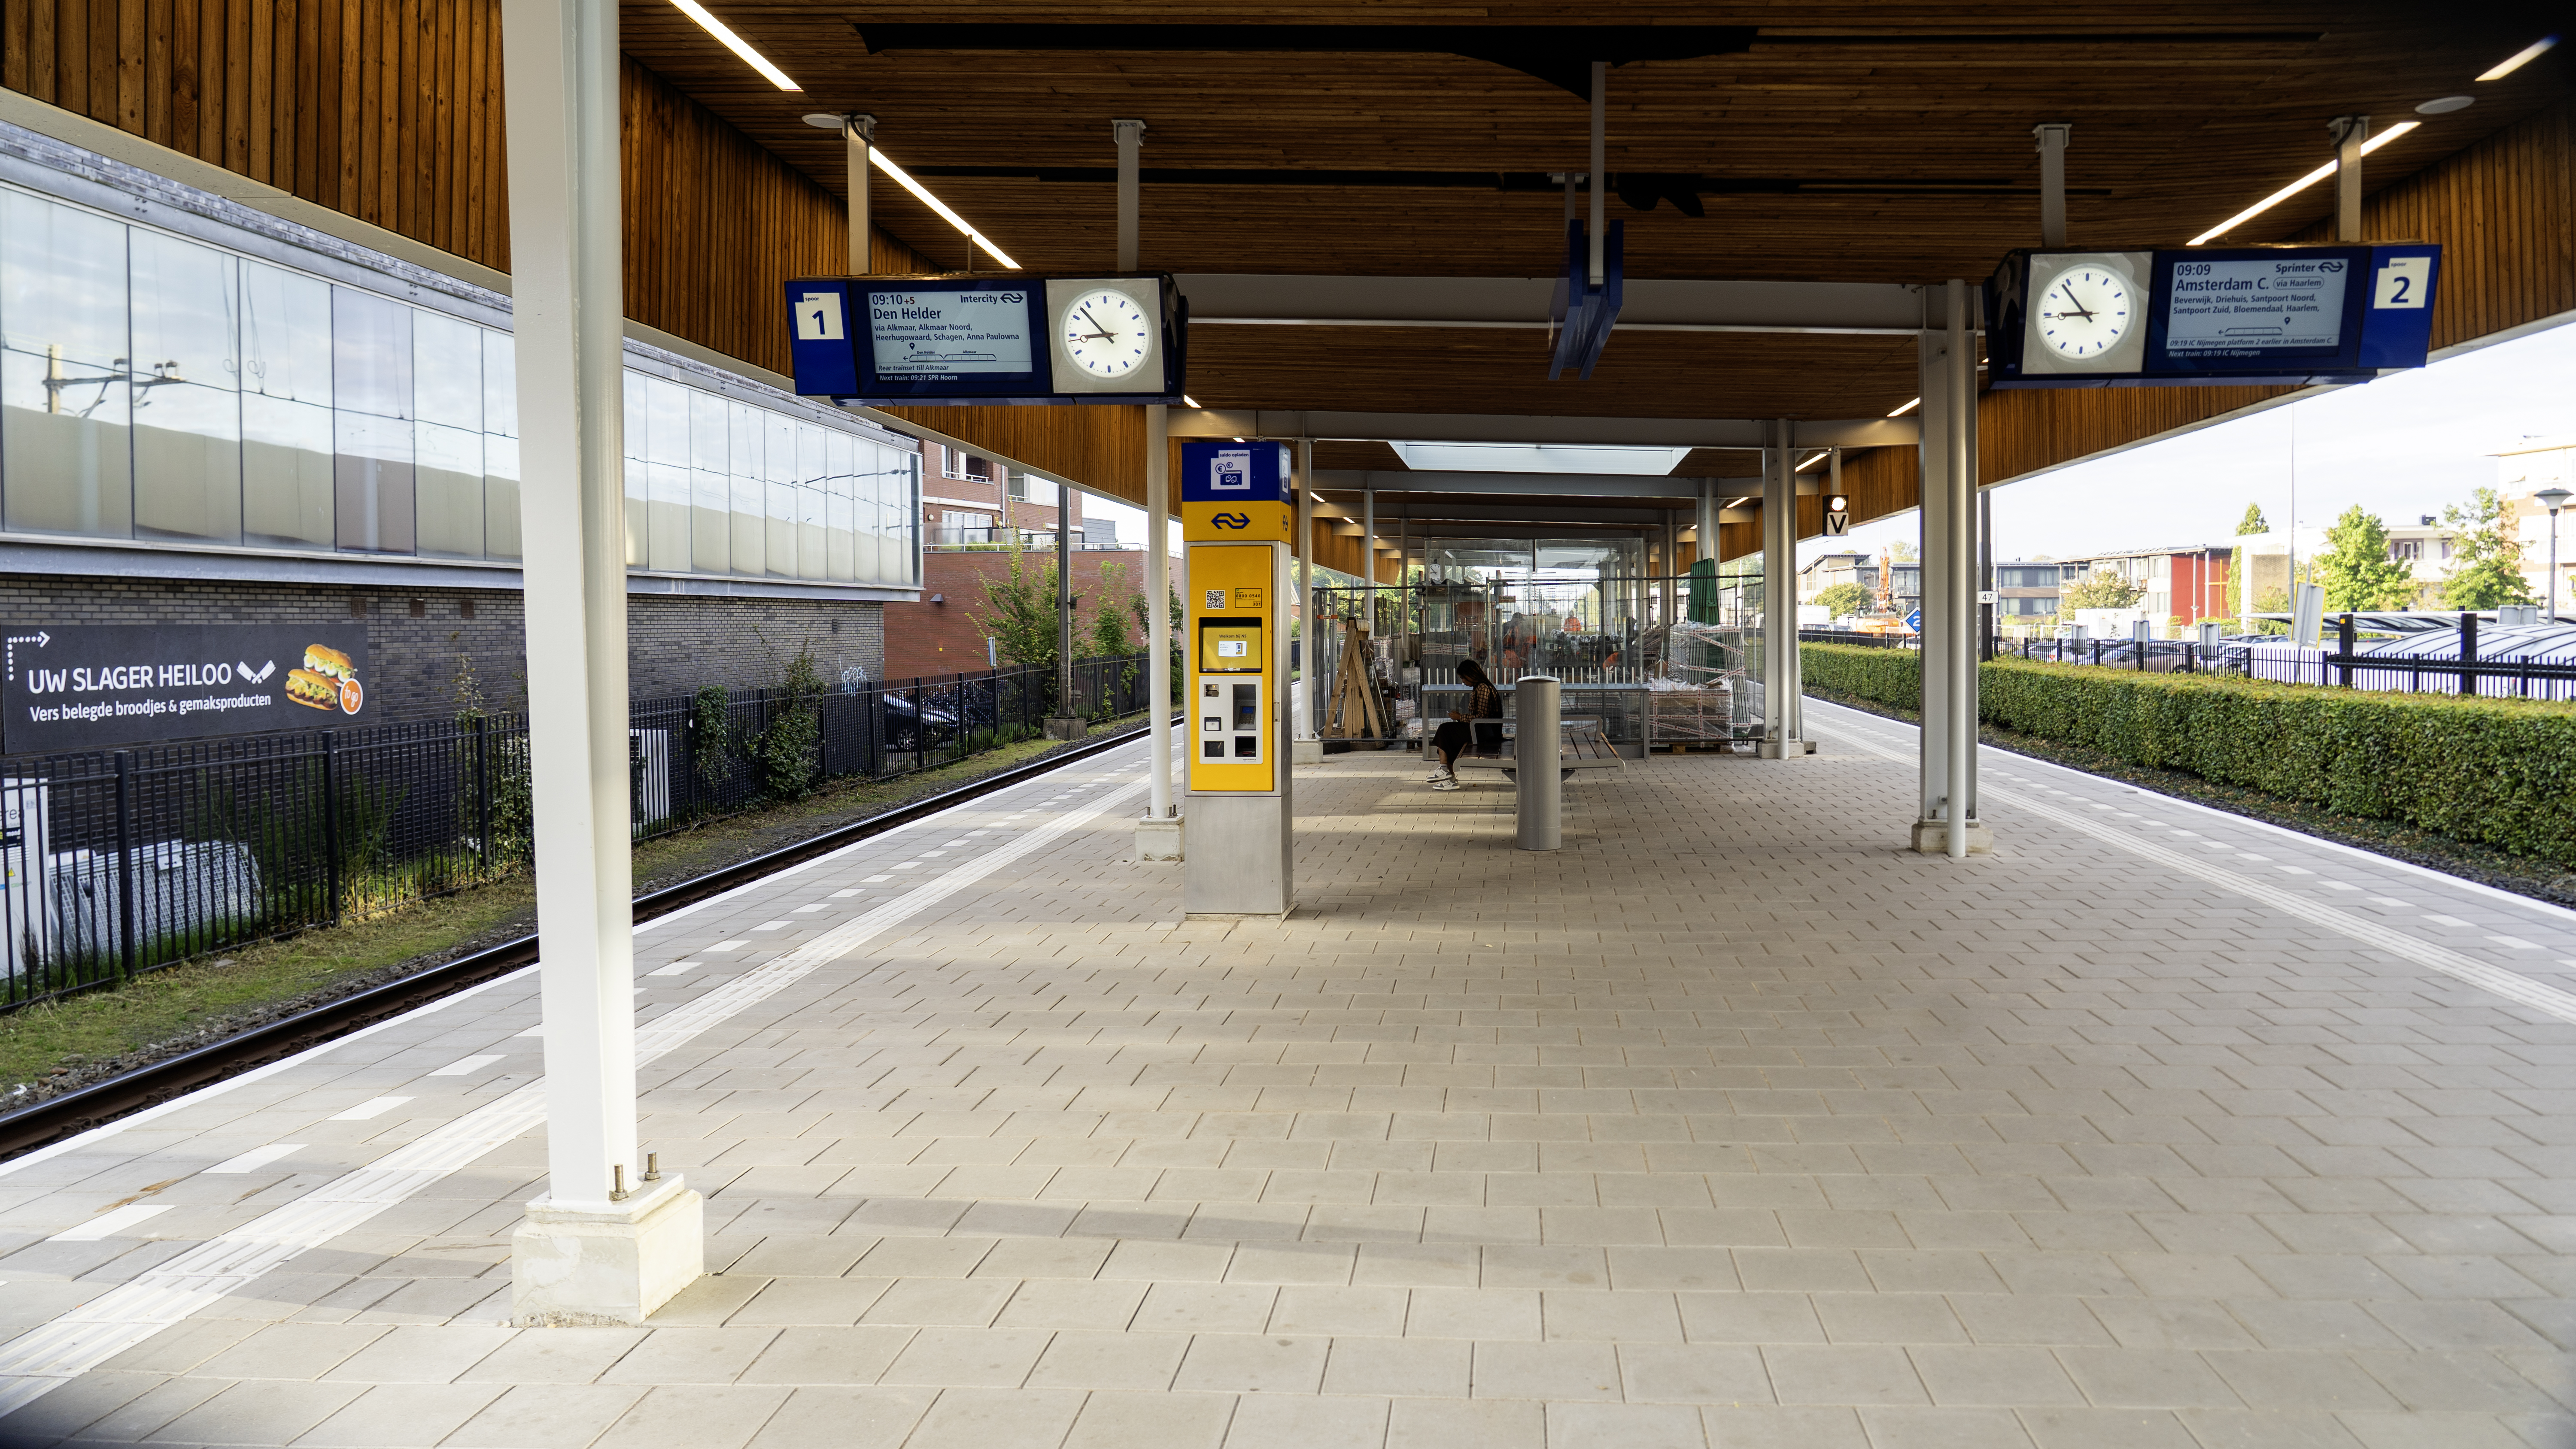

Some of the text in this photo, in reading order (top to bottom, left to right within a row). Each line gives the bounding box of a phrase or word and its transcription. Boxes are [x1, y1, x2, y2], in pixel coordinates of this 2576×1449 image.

[2177, 264, 2211, 276] 09:09
[2275, 263, 2315, 275] Sprinter
[2175, 277, 2269, 291] Amsterdam C.
[2391, 276, 2410, 303] 2
[872, 294, 915, 305] 09:10 +5
[960, 294, 998, 305] Intercity
[2174, 294, 2316, 305] Beverwijk, Driehuis, Santpoort Noord,
[874, 307, 942, 319] Den Helder
[2173, 304, 2320, 315] Santpoort Zuid, Bloemendaal, Haarlem,
[812, 310, 826, 335] 1
[949, 323, 972, 331] Noord,
[875, 333, 932, 342] Heerhugowaard,
[934, 333, 965, 342] Schagen,
[1829, 515, 1847, 534] V
[1913, 615, 1920, 627] 2
[28, 663, 232, 694] UW SLAGER HEILOO
[344, 685, 359, 708] to go
[30, 693, 271, 722] Vers belegde broodjes & gemaksproducten
